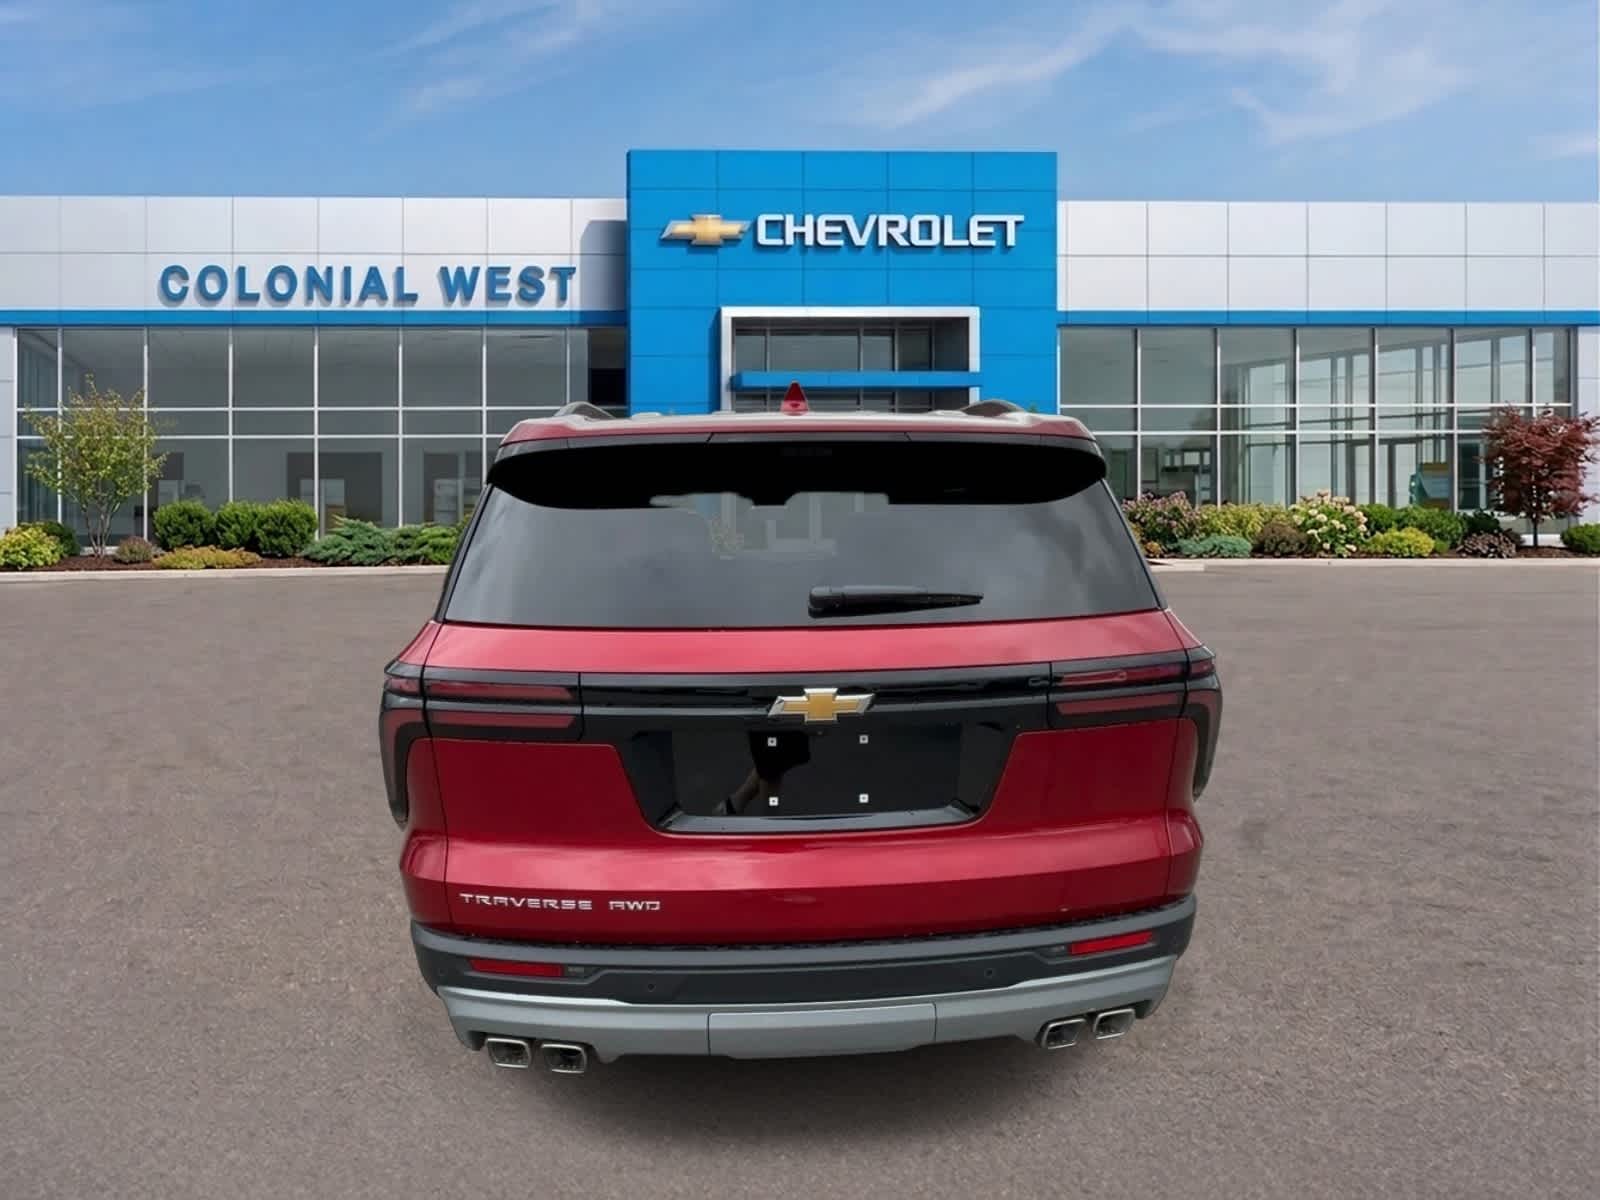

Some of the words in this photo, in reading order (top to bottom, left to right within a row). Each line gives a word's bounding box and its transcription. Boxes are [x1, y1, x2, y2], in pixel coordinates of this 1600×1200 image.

[756, 213, 1025, 248] CHEVROLET
[160, 264, 418, 305] COLONIAL
[438, 265, 577, 305] WEST
[459, 892, 593, 911] TRAVERSE
[608, 900, 662, 912] AWD
